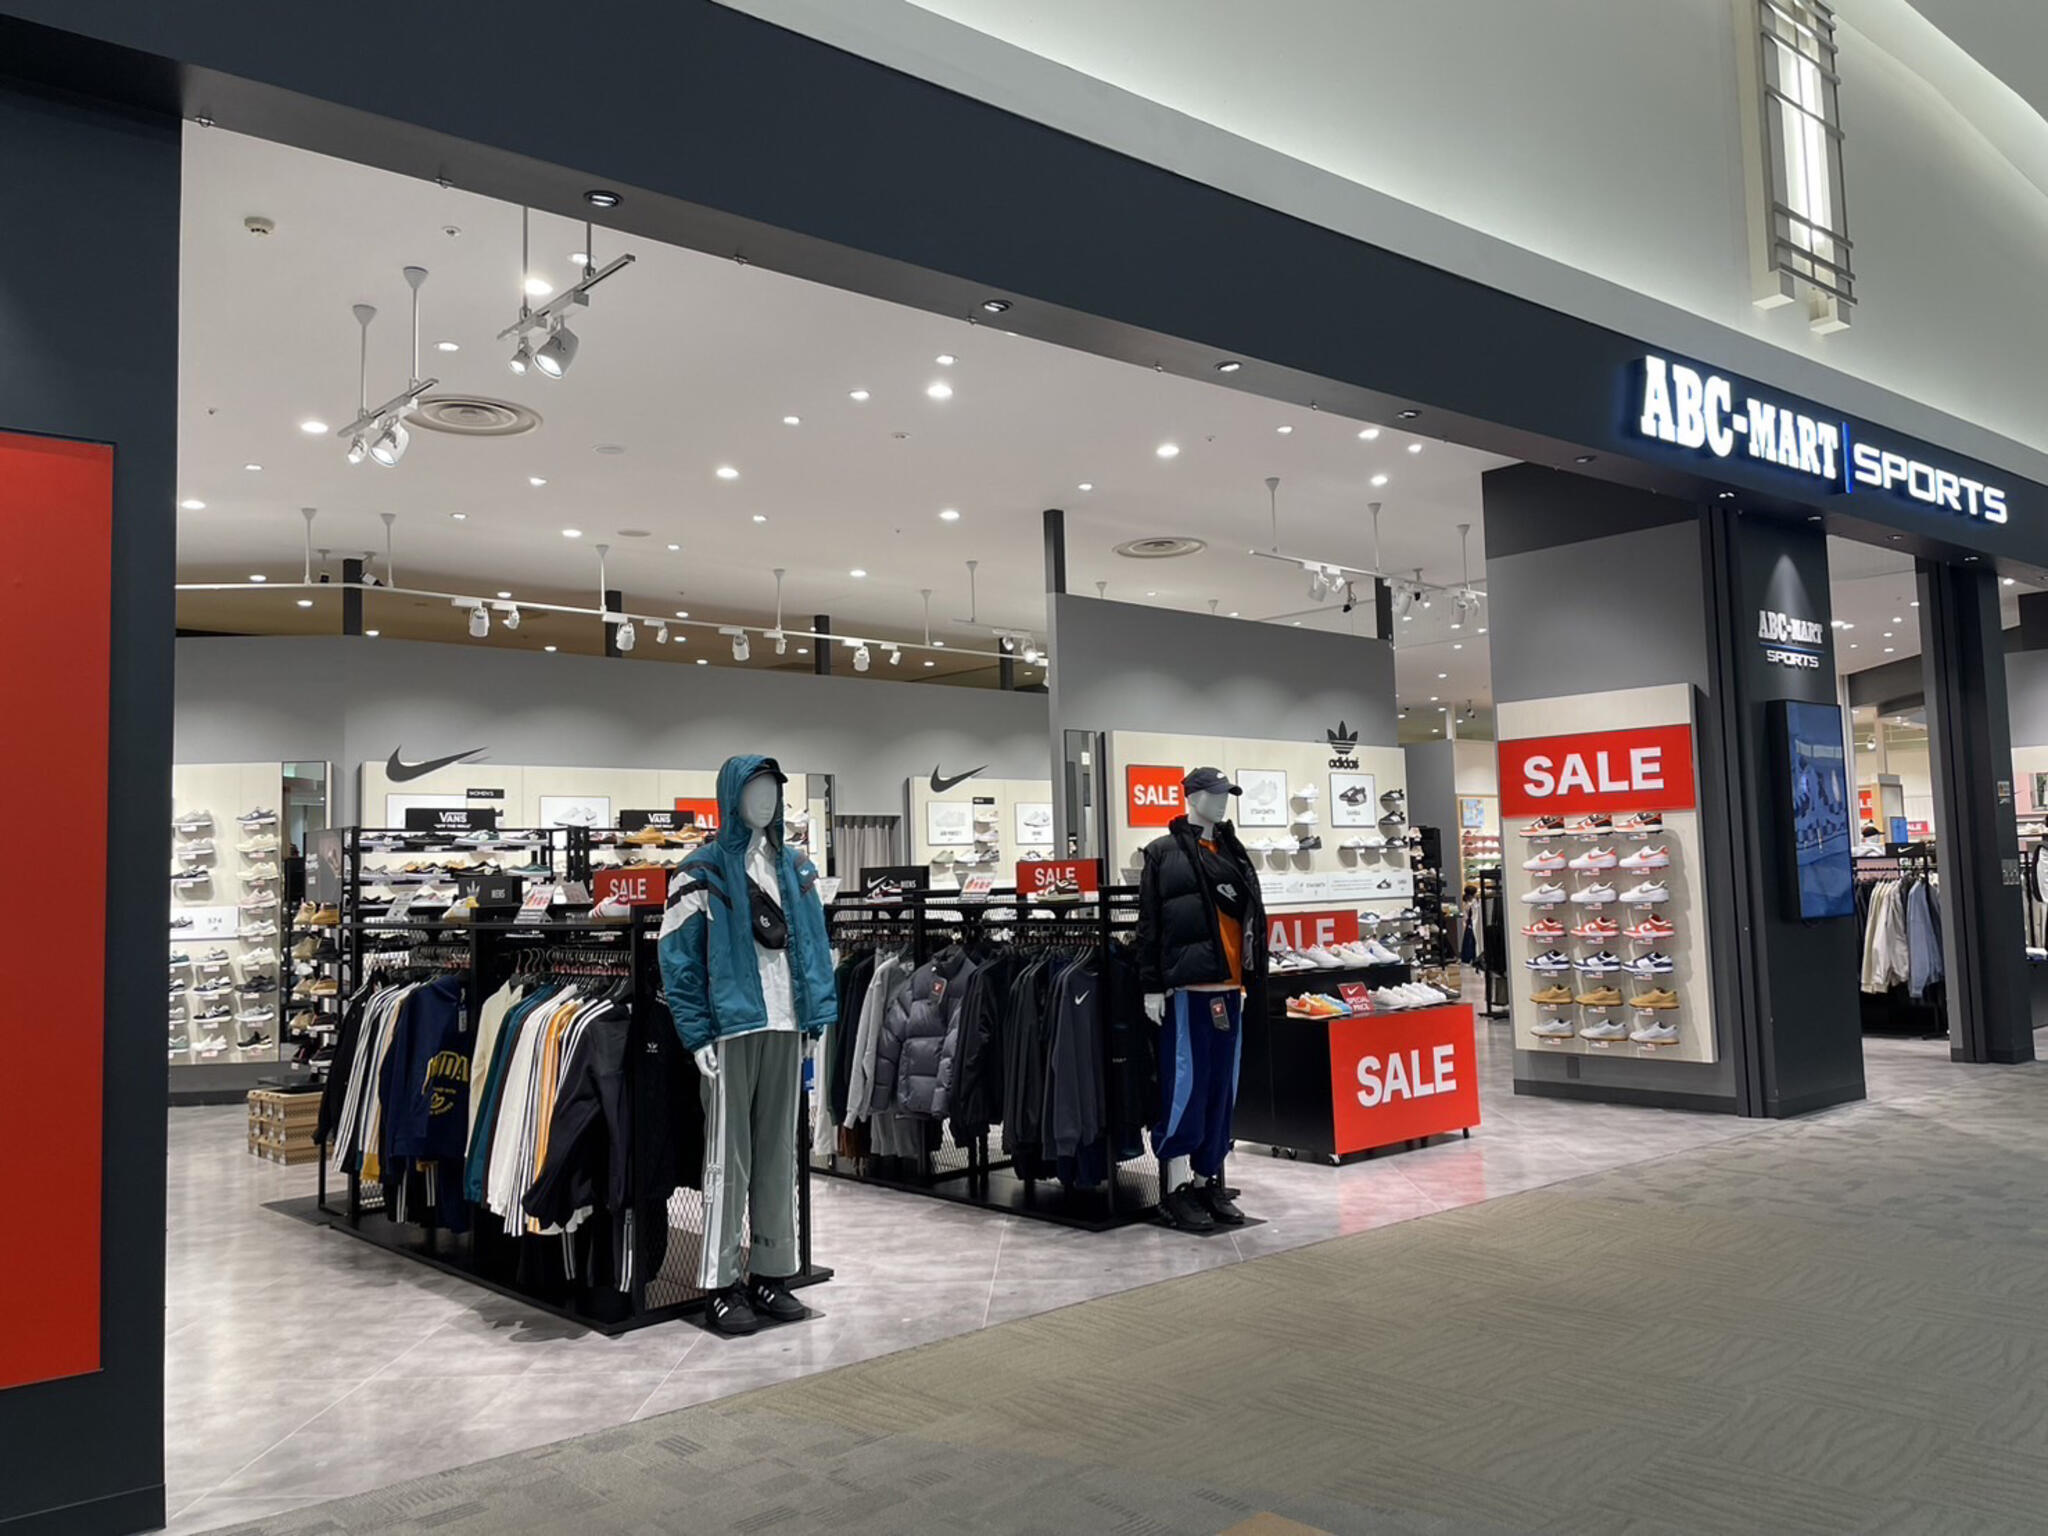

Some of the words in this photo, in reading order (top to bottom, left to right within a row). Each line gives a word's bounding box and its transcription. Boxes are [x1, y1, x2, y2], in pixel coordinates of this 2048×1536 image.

[1640, 355, 1838, 480] ABC-MART
[1853, 443, 2008, 524] SPORTS
[1758, 610, 1823, 644] ABC-MART
[1766, 649, 1819, 668] SPORTS
[1328, 756, 1360, 770] adidas
[1523, 746, 1665, 798] SALE
[1133, 784, 1180, 806] SALE
[439, 811, 468, 823] VANS
[648, 813, 672, 823] VANS
[609, 878, 647, 899] SALE
[1268, 918, 1335, 952] ALE
[1357, 1044, 1457, 1108] SALE
